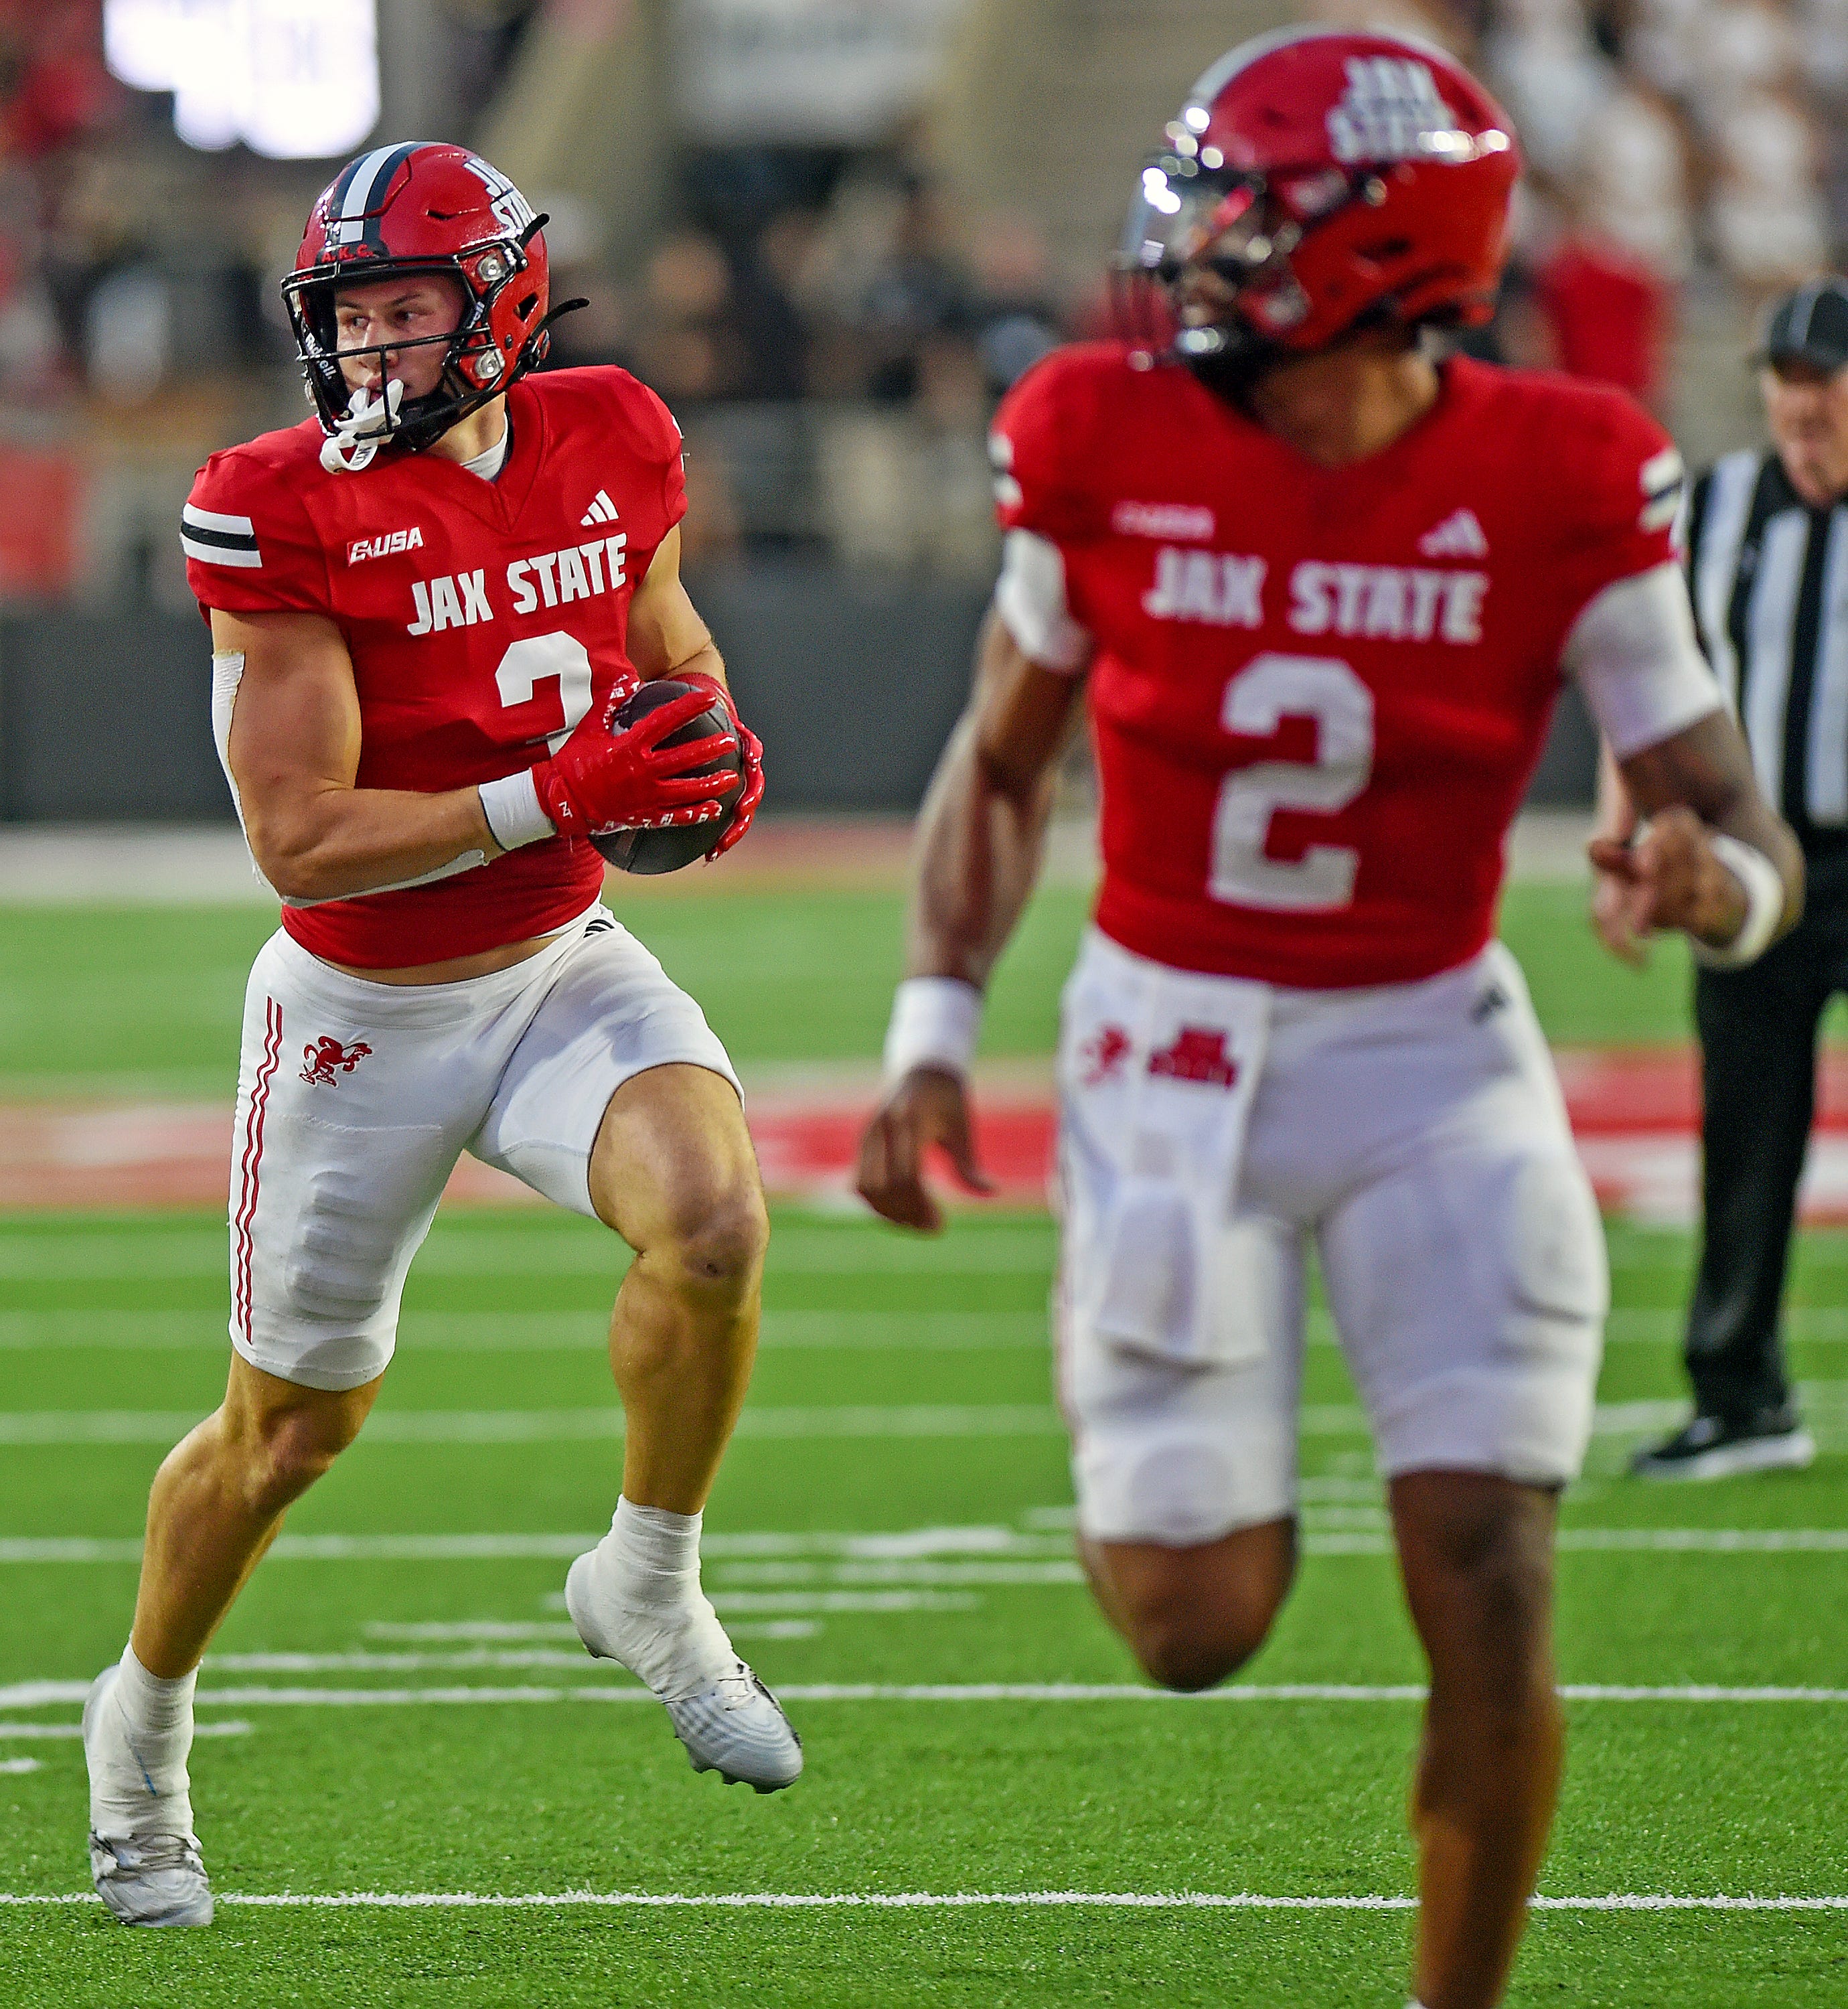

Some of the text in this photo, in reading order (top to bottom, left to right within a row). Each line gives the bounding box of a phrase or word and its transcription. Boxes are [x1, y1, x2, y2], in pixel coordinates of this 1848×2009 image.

[407, 533, 627, 636] JAX STATE
[1142, 545, 1490, 645] JAX STATE
[1208, 650, 1376, 913] 2
